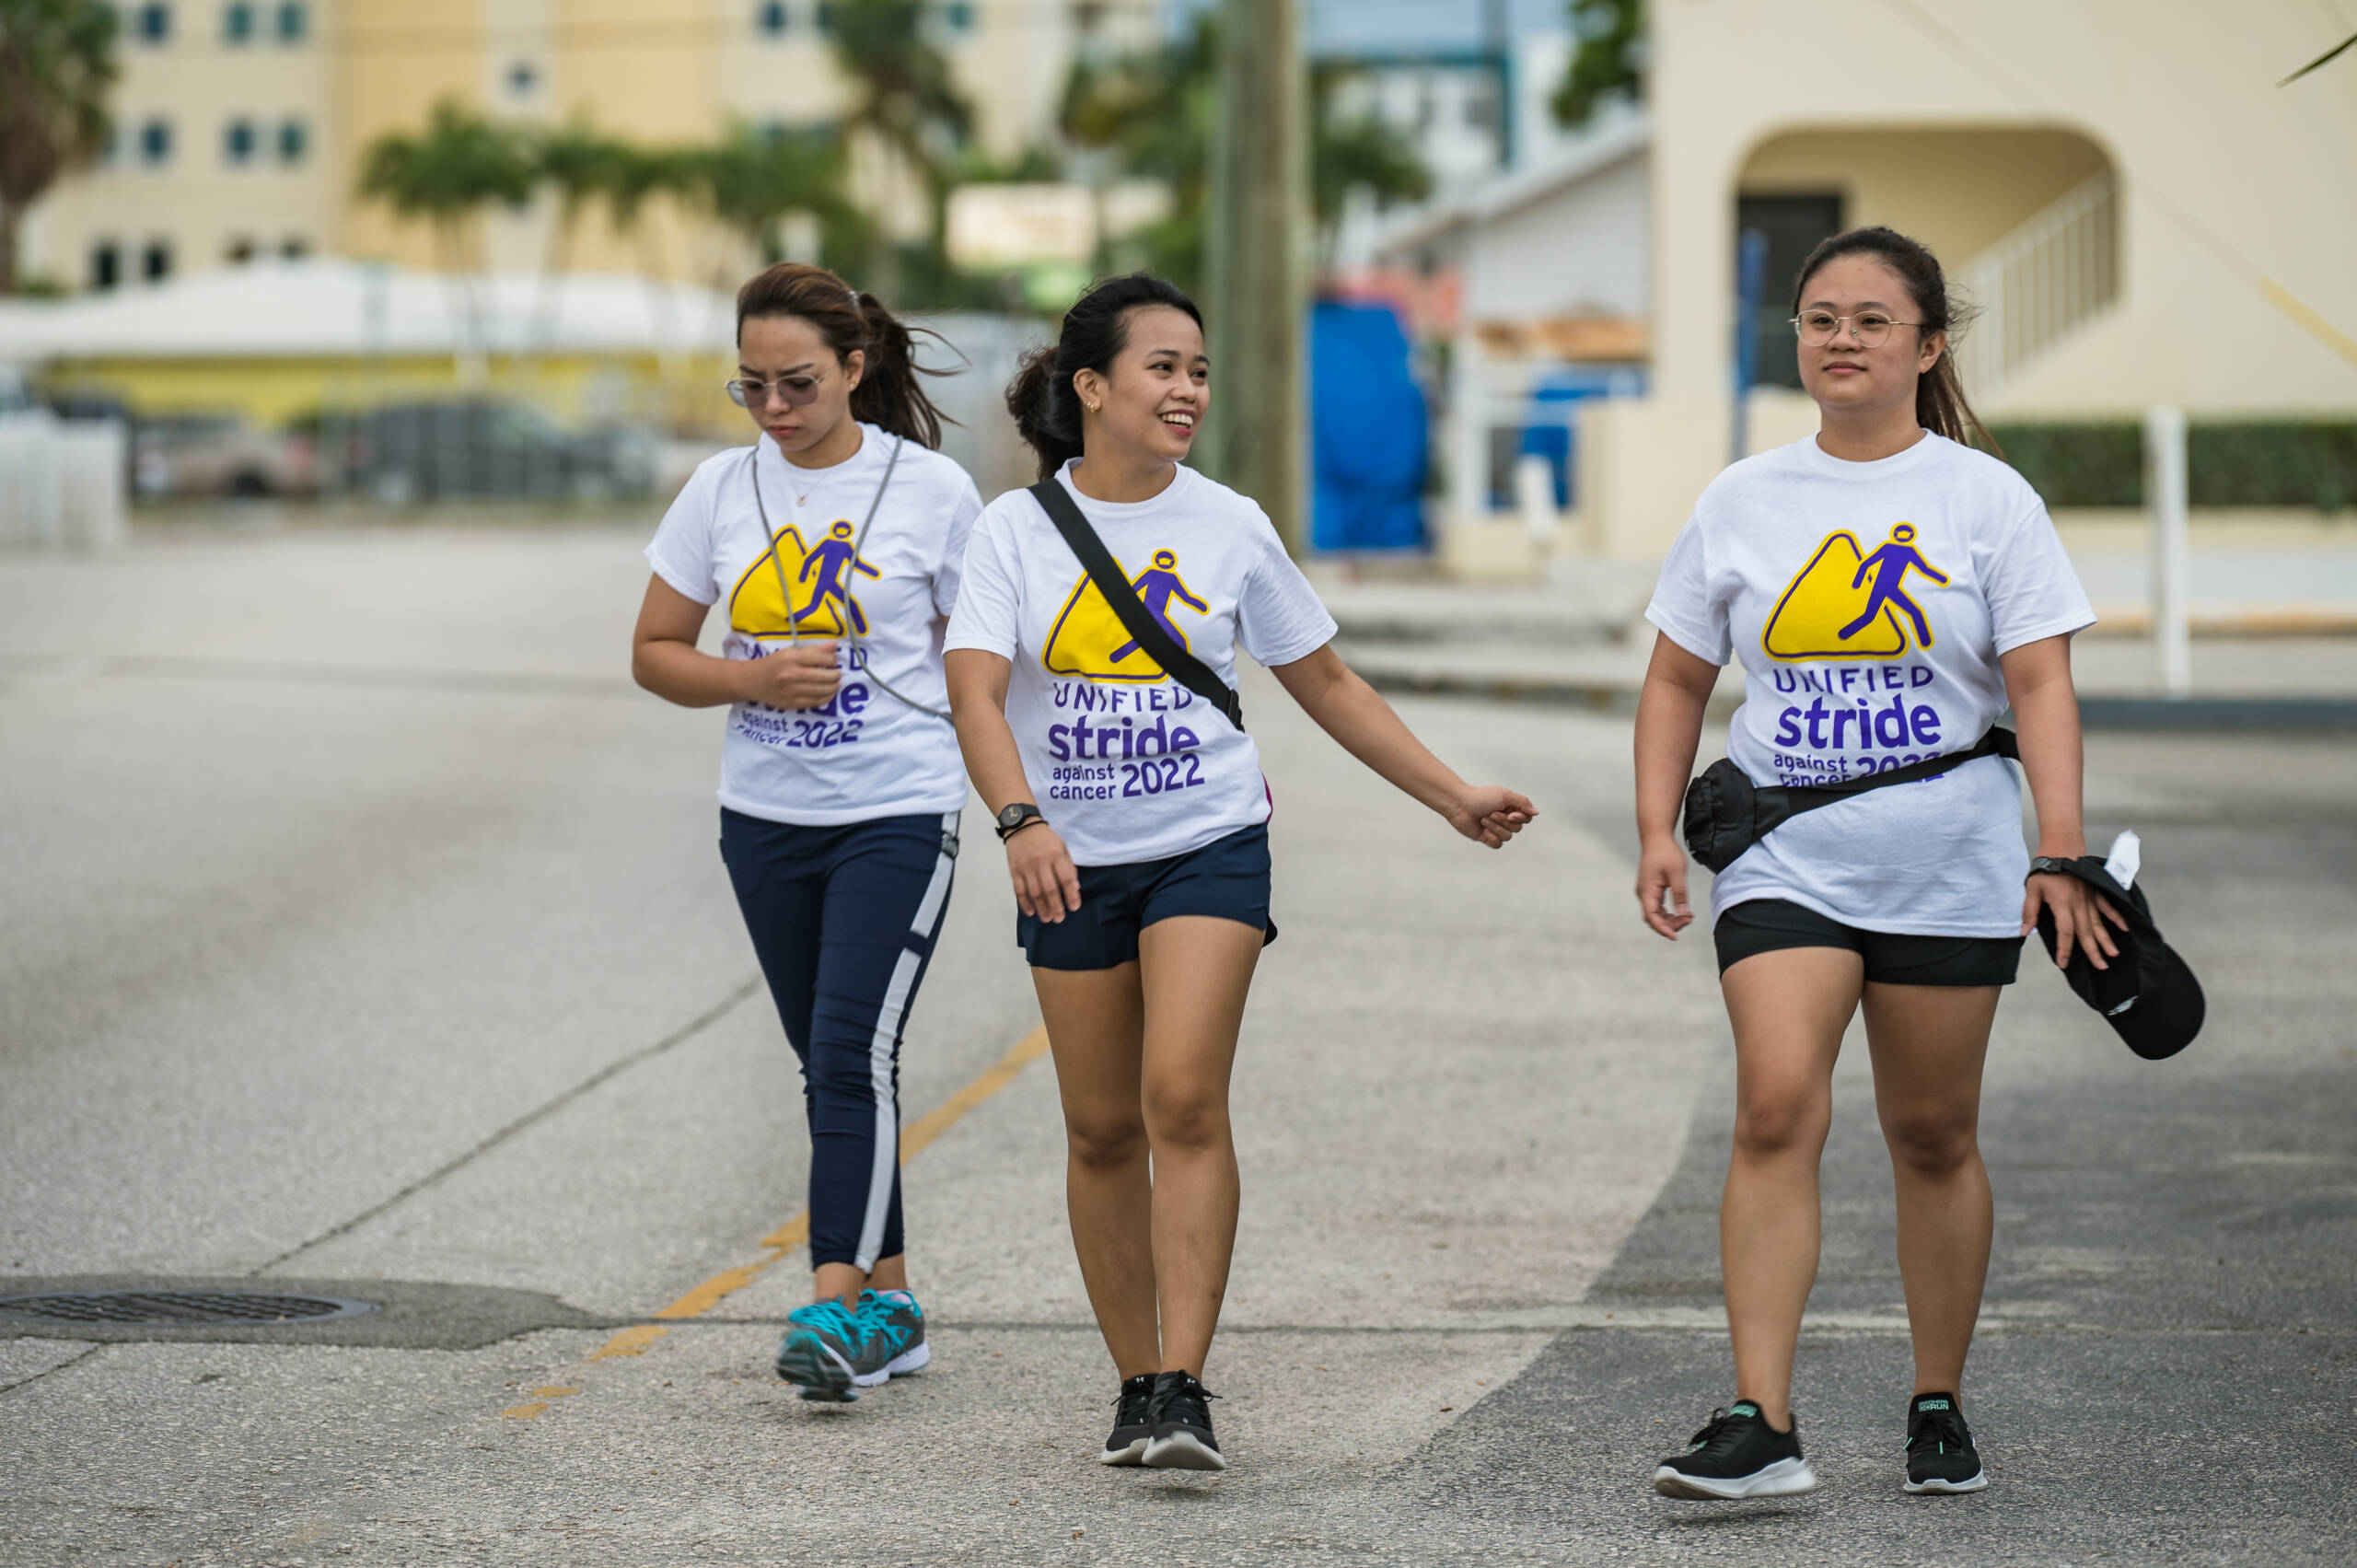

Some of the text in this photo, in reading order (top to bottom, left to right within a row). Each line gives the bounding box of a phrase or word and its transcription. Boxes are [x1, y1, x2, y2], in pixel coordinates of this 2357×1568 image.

[1773, 666, 1933, 694] UNIFIED
[1053, 682, 1193, 713] UNIFIED
[742, 710, 789, 732] against
[786, 718, 864, 749] 2022
[1774, 692, 1942, 749] stride
[1048, 714, 1201, 762] stride
[1050, 753, 1205, 800] cancer 2022
[1052, 762, 1115, 784] against
[1774, 754, 1848, 772] against
